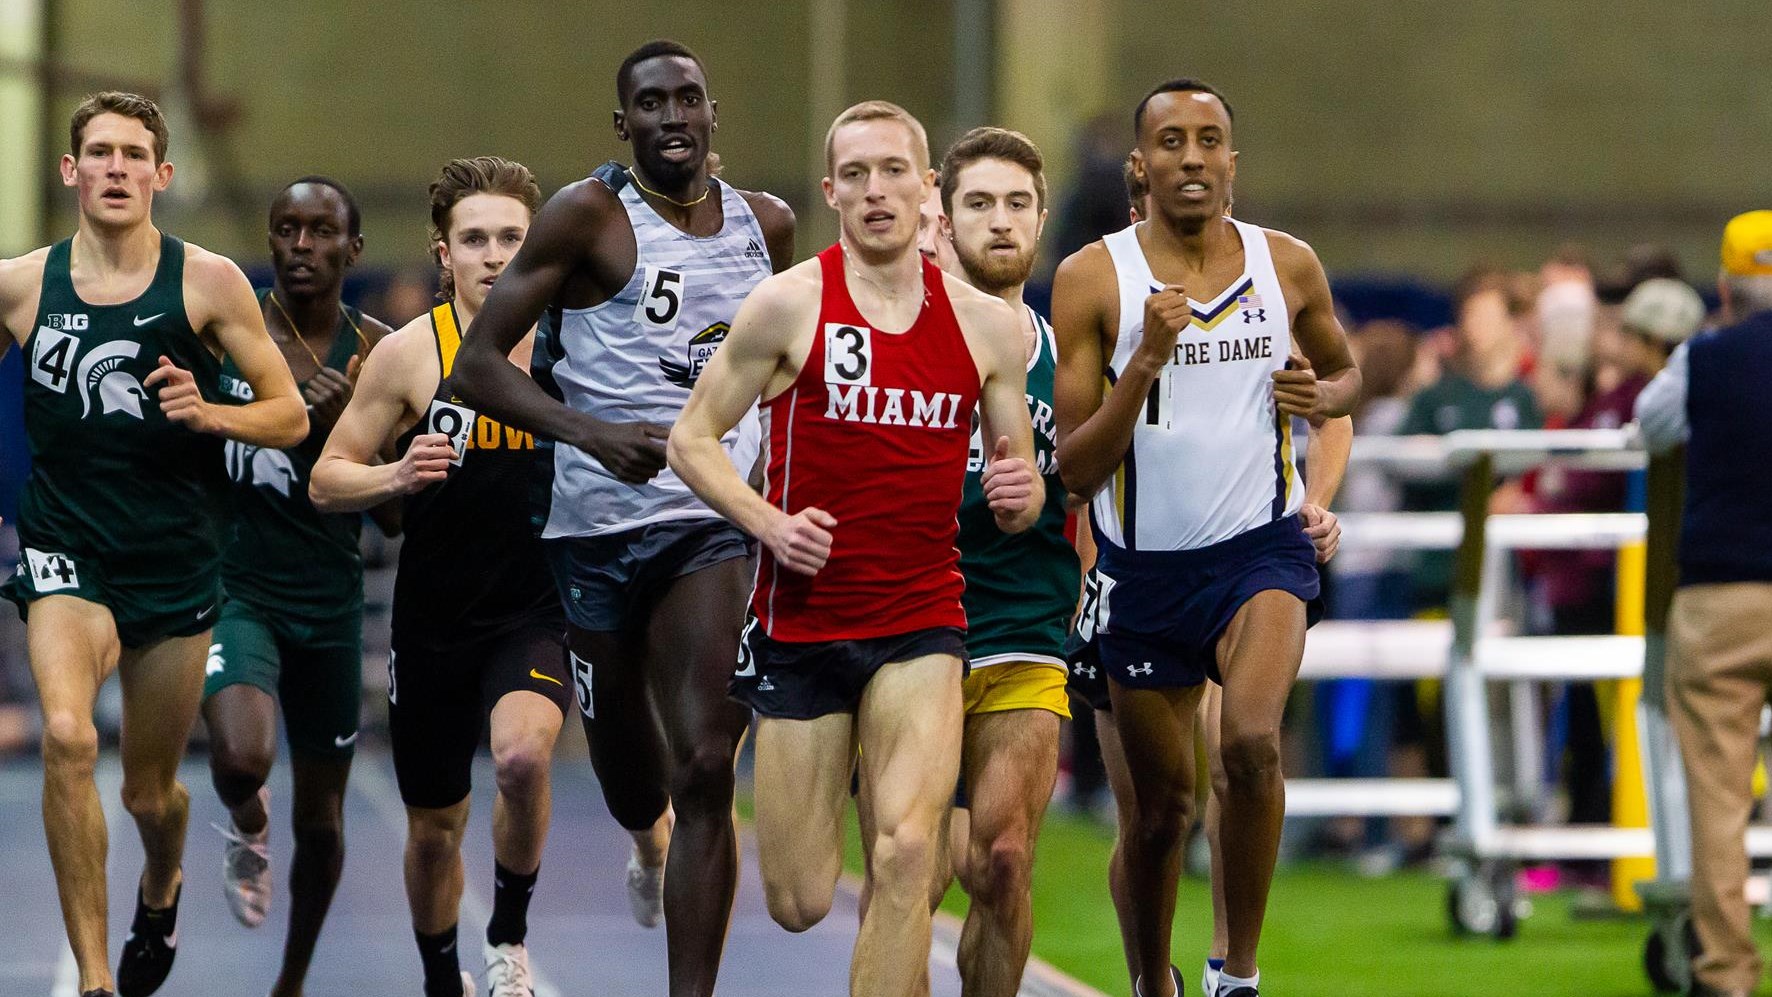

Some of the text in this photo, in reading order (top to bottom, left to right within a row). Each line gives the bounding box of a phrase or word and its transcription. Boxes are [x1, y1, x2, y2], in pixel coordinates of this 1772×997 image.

[645, 269, 681, 324] 5
[38, 336, 72, 387] 4
[834, 326, 868, 381] 3
[1173, 336, 1272, 365] TRE DAME
[824, 384, 962, 429] MIAMI
[41, 555, 74, 584] 4
[575, 656, 591, 712] 5
